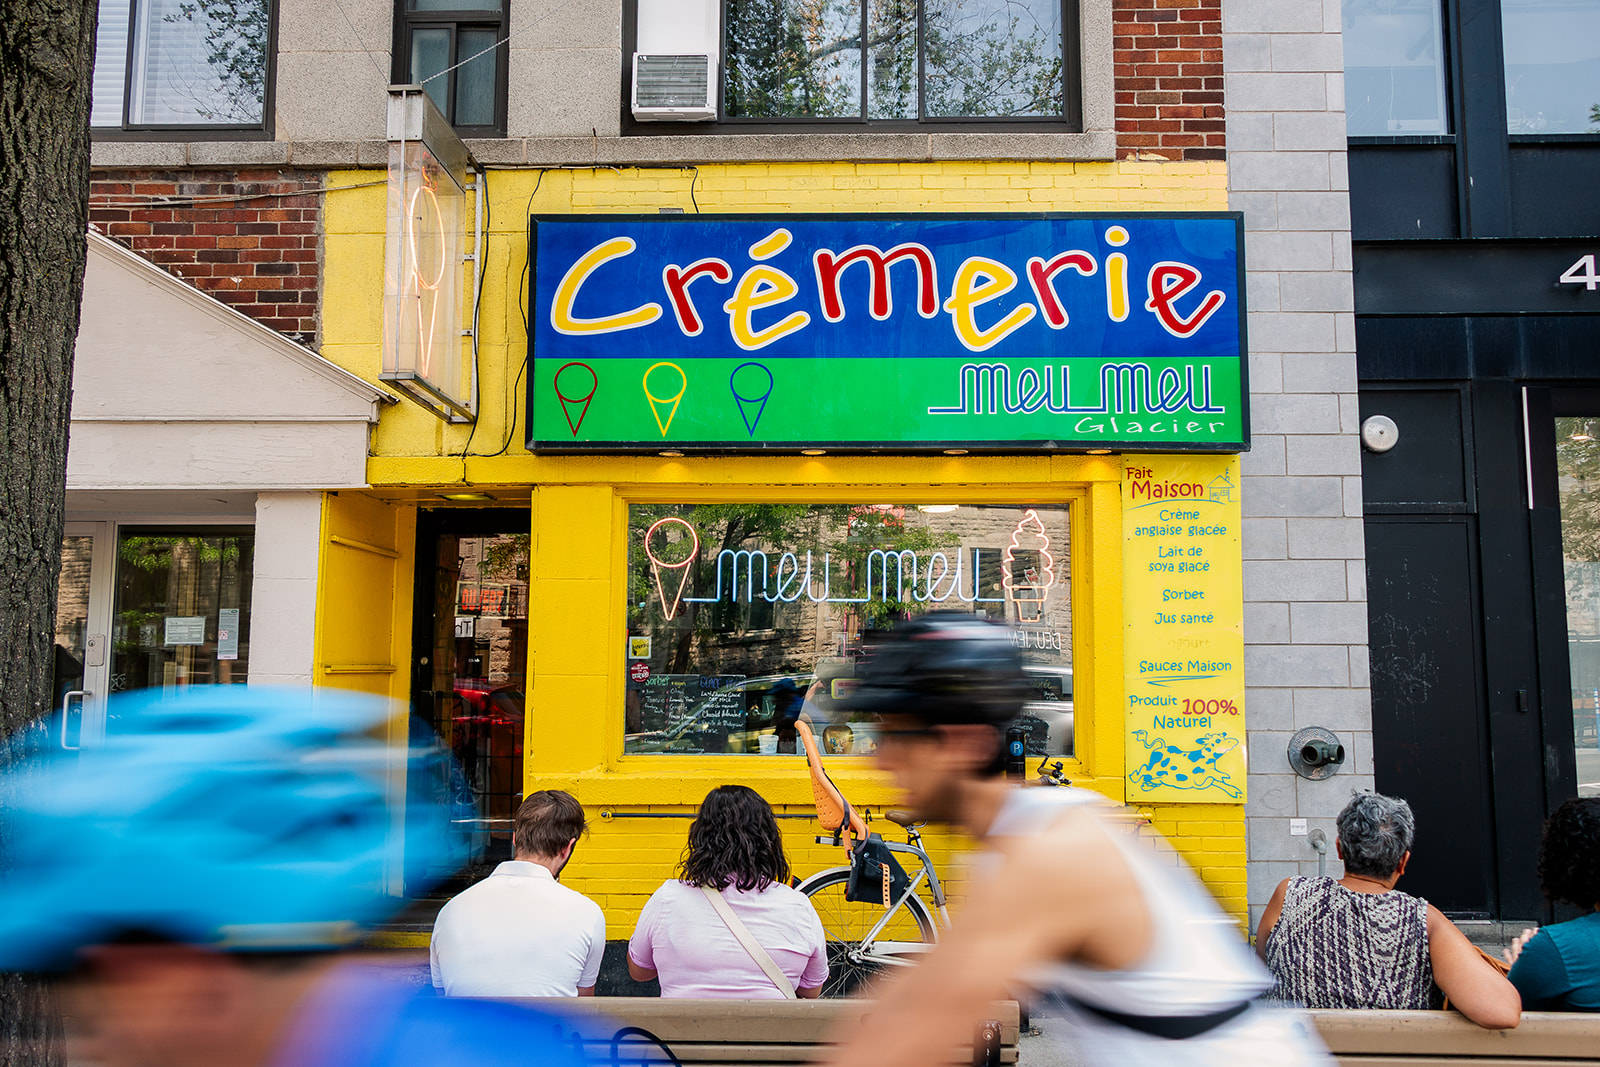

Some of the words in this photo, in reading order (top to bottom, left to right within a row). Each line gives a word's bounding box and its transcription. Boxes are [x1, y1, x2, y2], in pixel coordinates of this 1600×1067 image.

[550, 225, 1226, 352] Crémerie
[958, 362, 1069, 414] meu
[1100, 362, 1226, 414] meu
[1074, 416, 1225, 434] Glacier
[1125, 466, 1153, 480] Fait
[1131, 480, 1204, 500] Maison
[1159, 508, 1200, 522] Crème
[1134, 525, 1183, 537] anglaise
[1188, 523, 1227, 537] glacée
[1158, 546, 1184, 558] Lait
[1187, 546, 1203, 557] de
[1148, 562, 1175, 572] soya
[1178, 560, 1210, 573] glacé
[716, 549, 830, 602] meu
[866, 548, 980, 602] meu
[1162, 588, 1205, 602] Sorbet
[1154, 612, 1177, 625] Jus
[1180, 611, 1214, 624] santé
[1139, 660, 1183, 673] Sauces
[1187, 660, 1232, 673] Maison
[1128, 695, 1178, 707] Produit
[1182, 698, 1238, 716] 100%
[1153, 715, 1212, 729] Naturel
